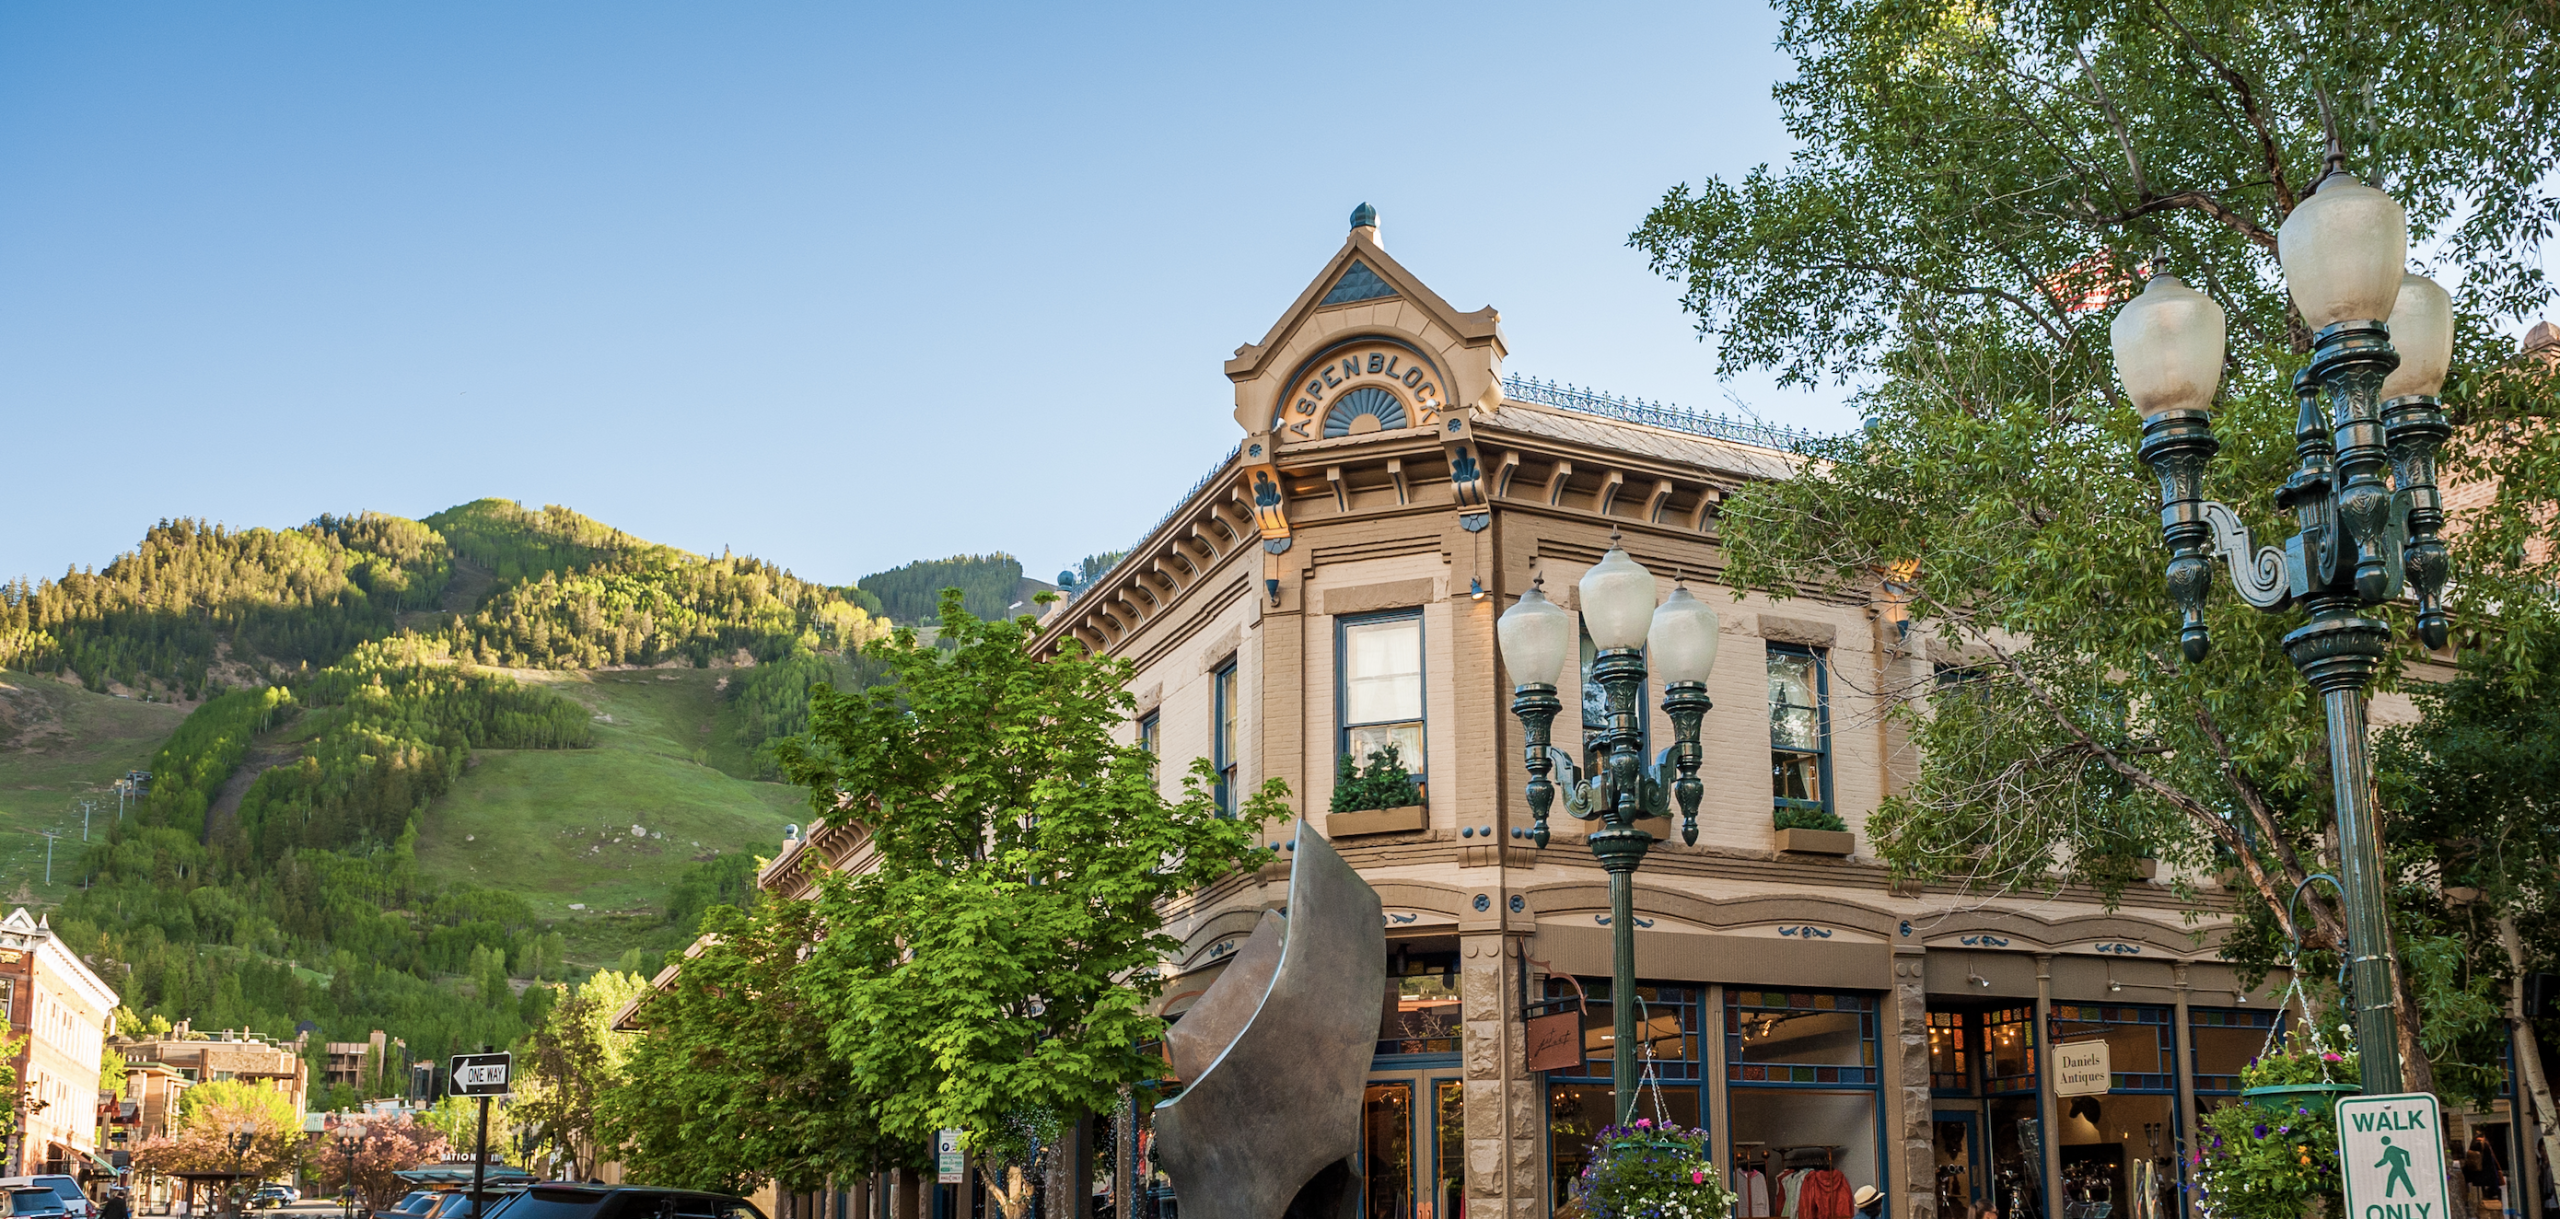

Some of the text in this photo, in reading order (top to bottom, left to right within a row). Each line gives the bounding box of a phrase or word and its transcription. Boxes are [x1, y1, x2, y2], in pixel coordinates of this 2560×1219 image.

[1290, 352, 1441, 438] ASPEN BLOCK
[2062, 1053, 2101, 1069] Daniels
[468, 1066, 504, 1083] ONE WAY
[2060, 1071, 2105, 1087] Antiques
[2351, 1110, 2427, 1133] WALK
[2365, 1202, 2431, 1219] ONLY
